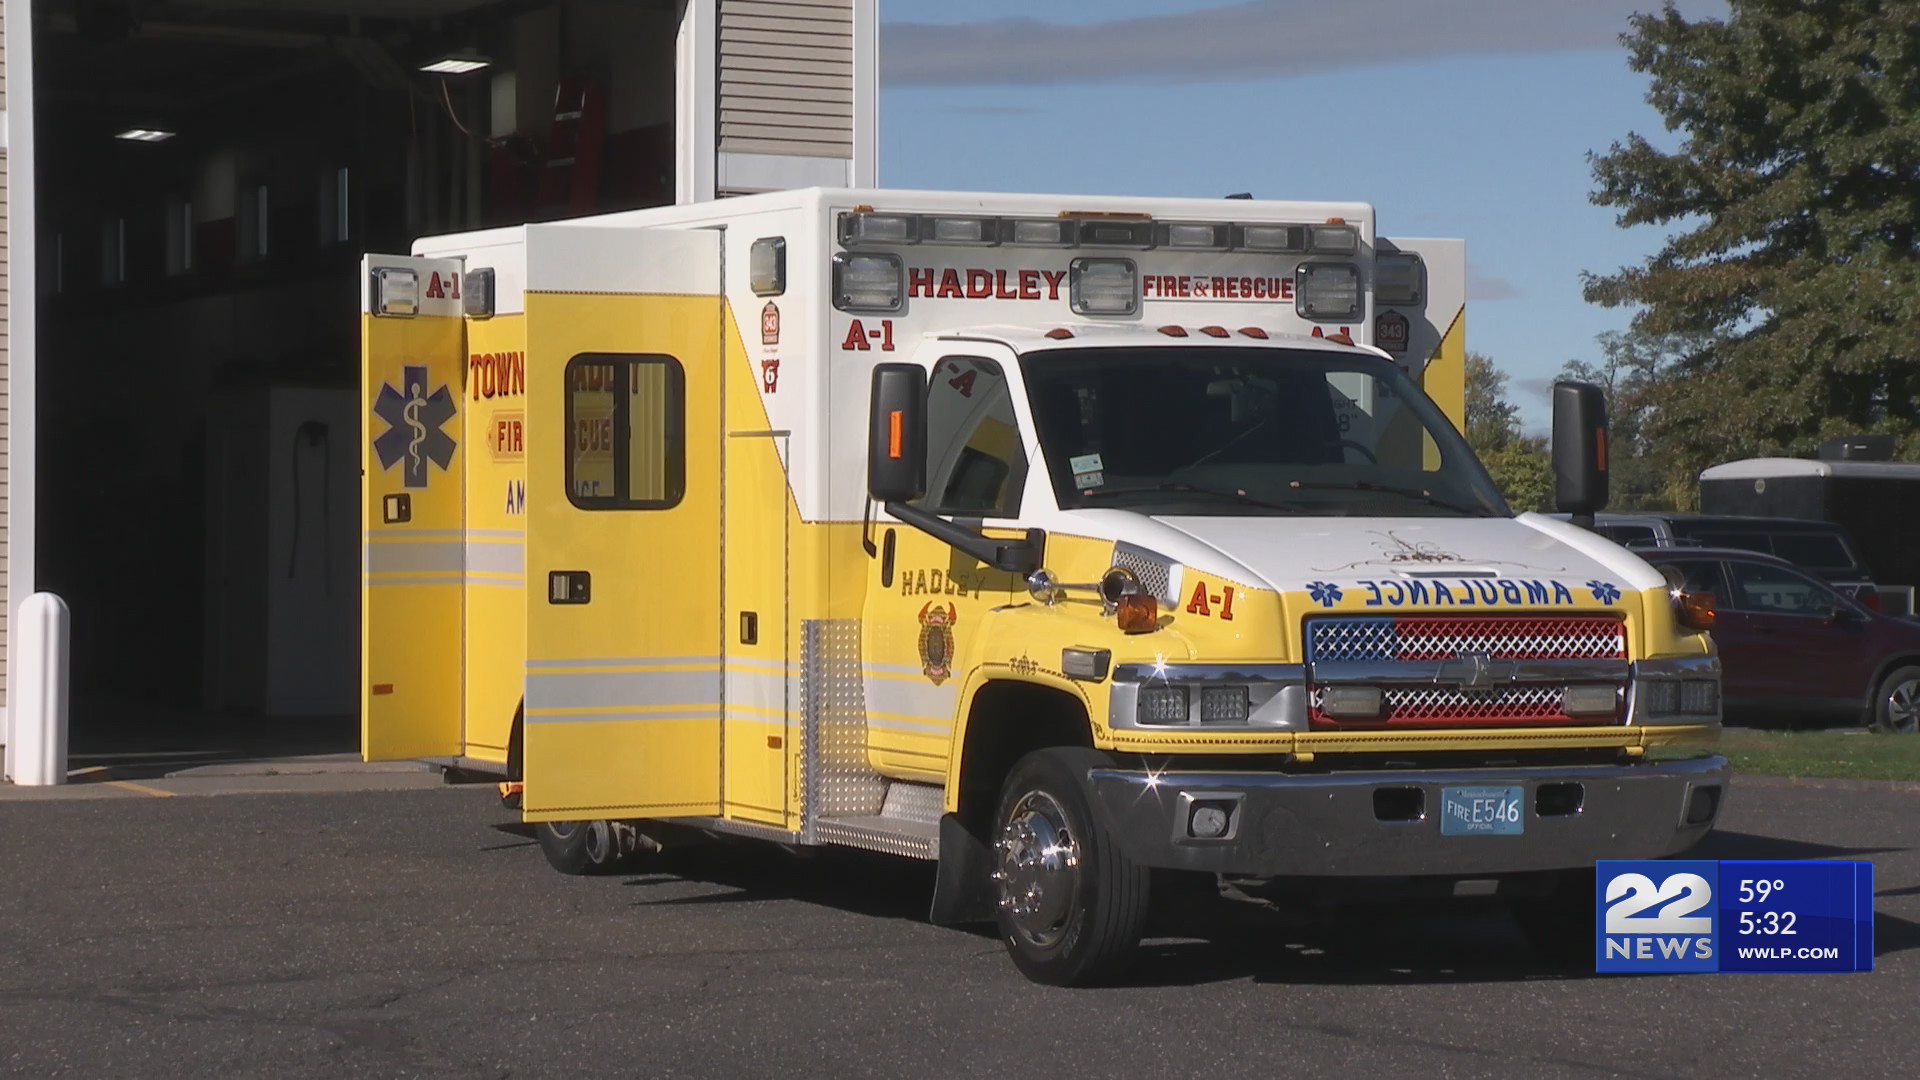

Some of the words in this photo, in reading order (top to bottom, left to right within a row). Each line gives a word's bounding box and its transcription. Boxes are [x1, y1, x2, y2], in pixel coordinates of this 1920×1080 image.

[426, 271, 460, 299] A-1
[908, 268, 1067, 300] HADLEY
[1143, 275, 1191, 297] FIRE
[1212, 276, 1294, 299] RESCUE
[842, 320, 894, 351] A-1
[1380, 324, 1402, 338] 343
[470, 352, 524, 401] TOWN
[498, 421, 522, 452] FIR
[579, 420, 611, 451] CUE
[902, 568, 986, 600] HADLEY
[1186, 581, 1234, 621] A-1
[1447, 800, 1471, 822] FIRE
[1472, 799, 1520, 822] E546
